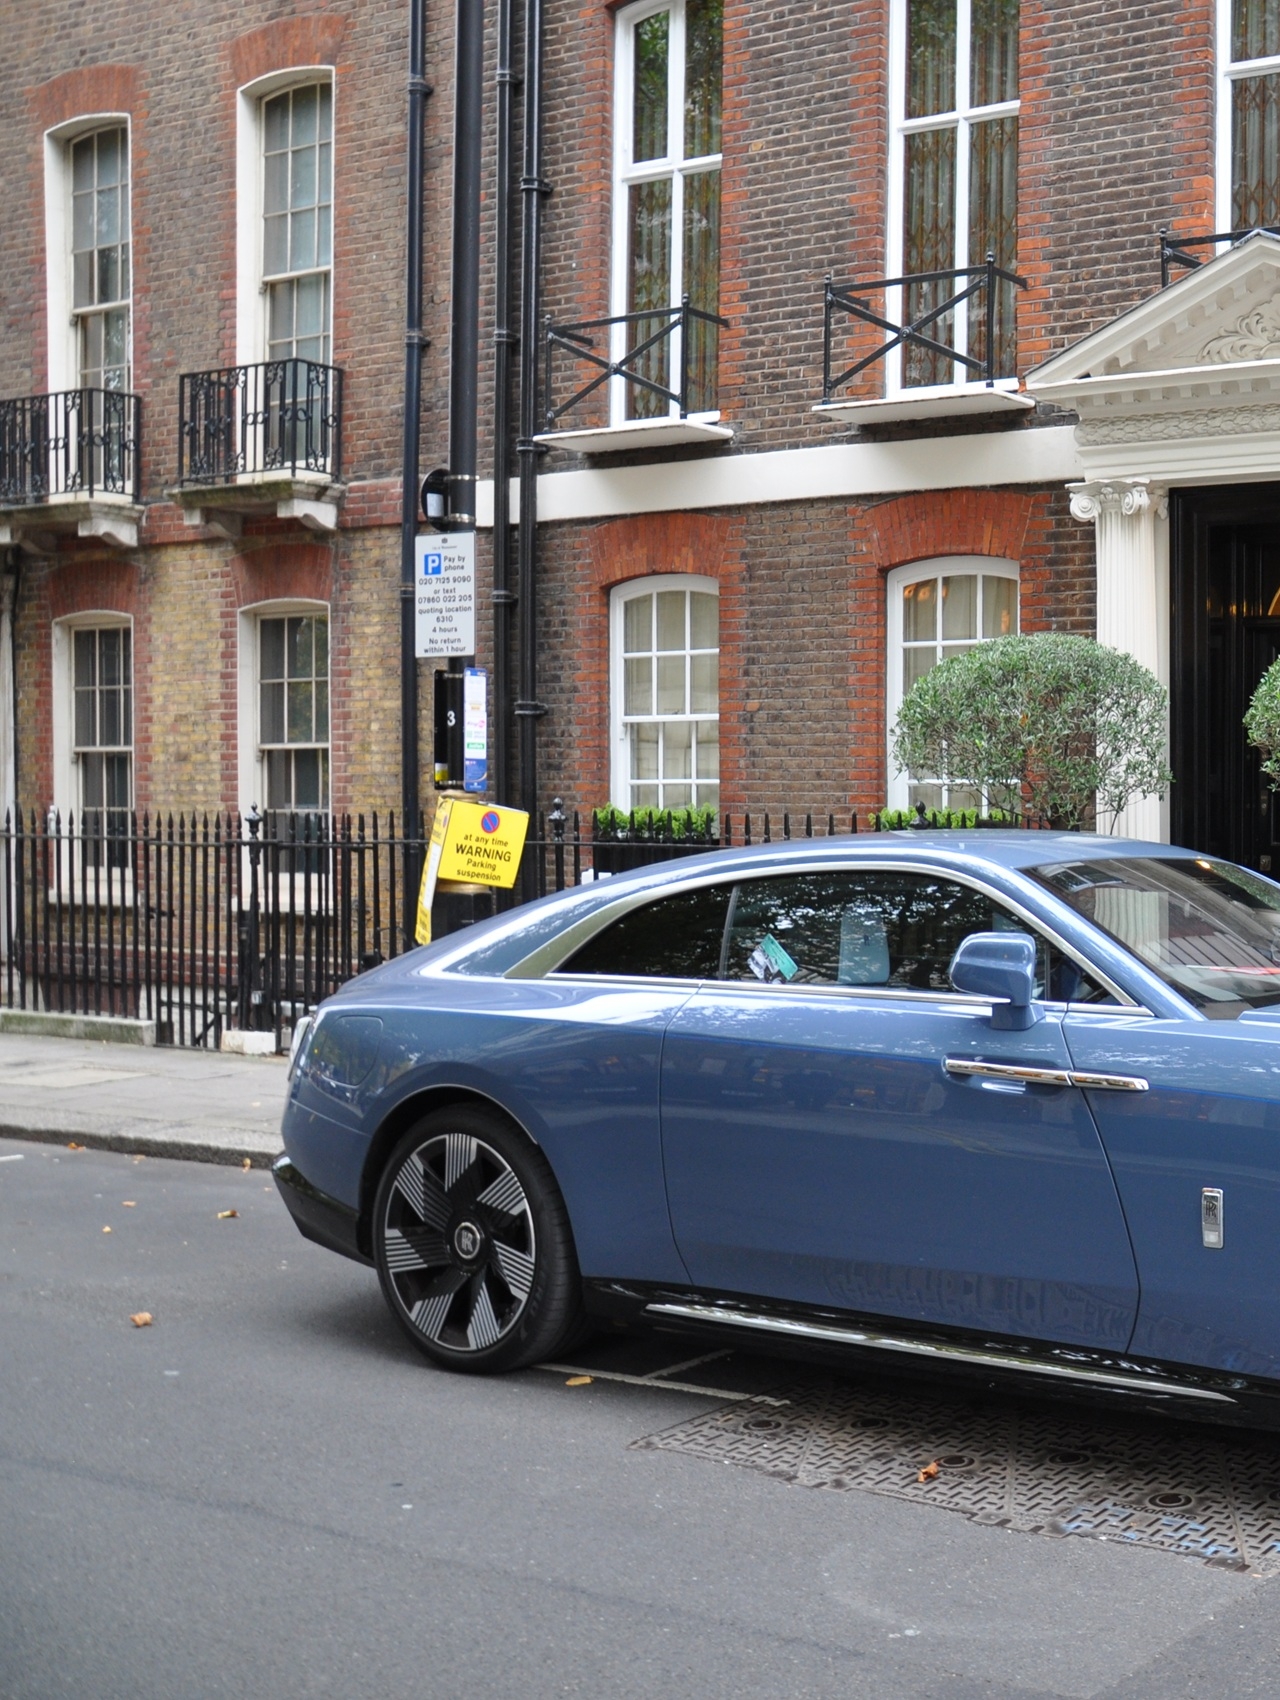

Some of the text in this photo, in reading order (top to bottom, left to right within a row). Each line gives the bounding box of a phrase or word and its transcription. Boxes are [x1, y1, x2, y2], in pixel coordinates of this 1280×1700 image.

[427, 555, 439, 574] P
[443, 554, 465, 563] Pay by
[444, 564, 464, 572] phone
[419, 577, 433, 585] 020
[435, 576, 450, 584] 7125
[442, 595, 456, 603] 022
[418, 605, 472, 615] quoting location
[436, 615, 453, 623] 6310
[447, 710, 456, 727] 3
[475, 835, 489, 845] any
[491, 838, 509, 847] time
[455, 843, 511, 862] WARNING
[466, 858, 497, 871] Parking
[456, 869, 501, 882] suspension
[1111, 1501, 1197, 1521] vodafone
